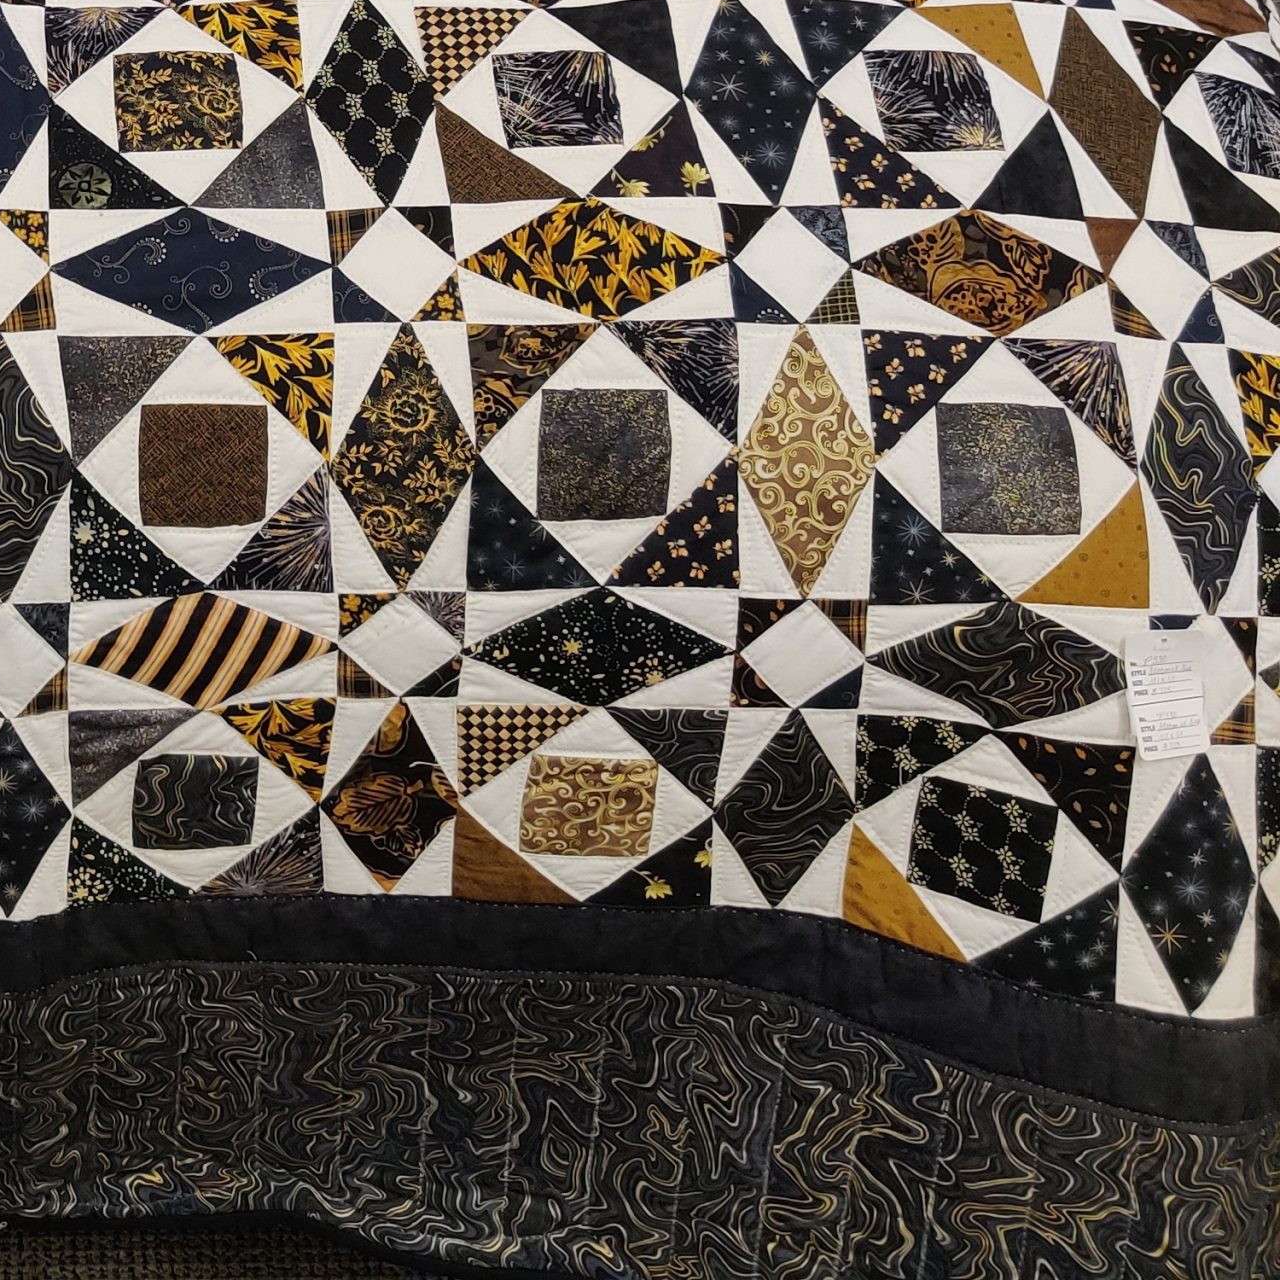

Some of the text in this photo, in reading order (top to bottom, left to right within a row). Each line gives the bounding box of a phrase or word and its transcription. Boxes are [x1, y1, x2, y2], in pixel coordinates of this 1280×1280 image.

[1131, 669, 1146, 677] STYLE
[1140, 724, 1156, 732] STYLE
[1144, 745, 1158, 753] PRICE
